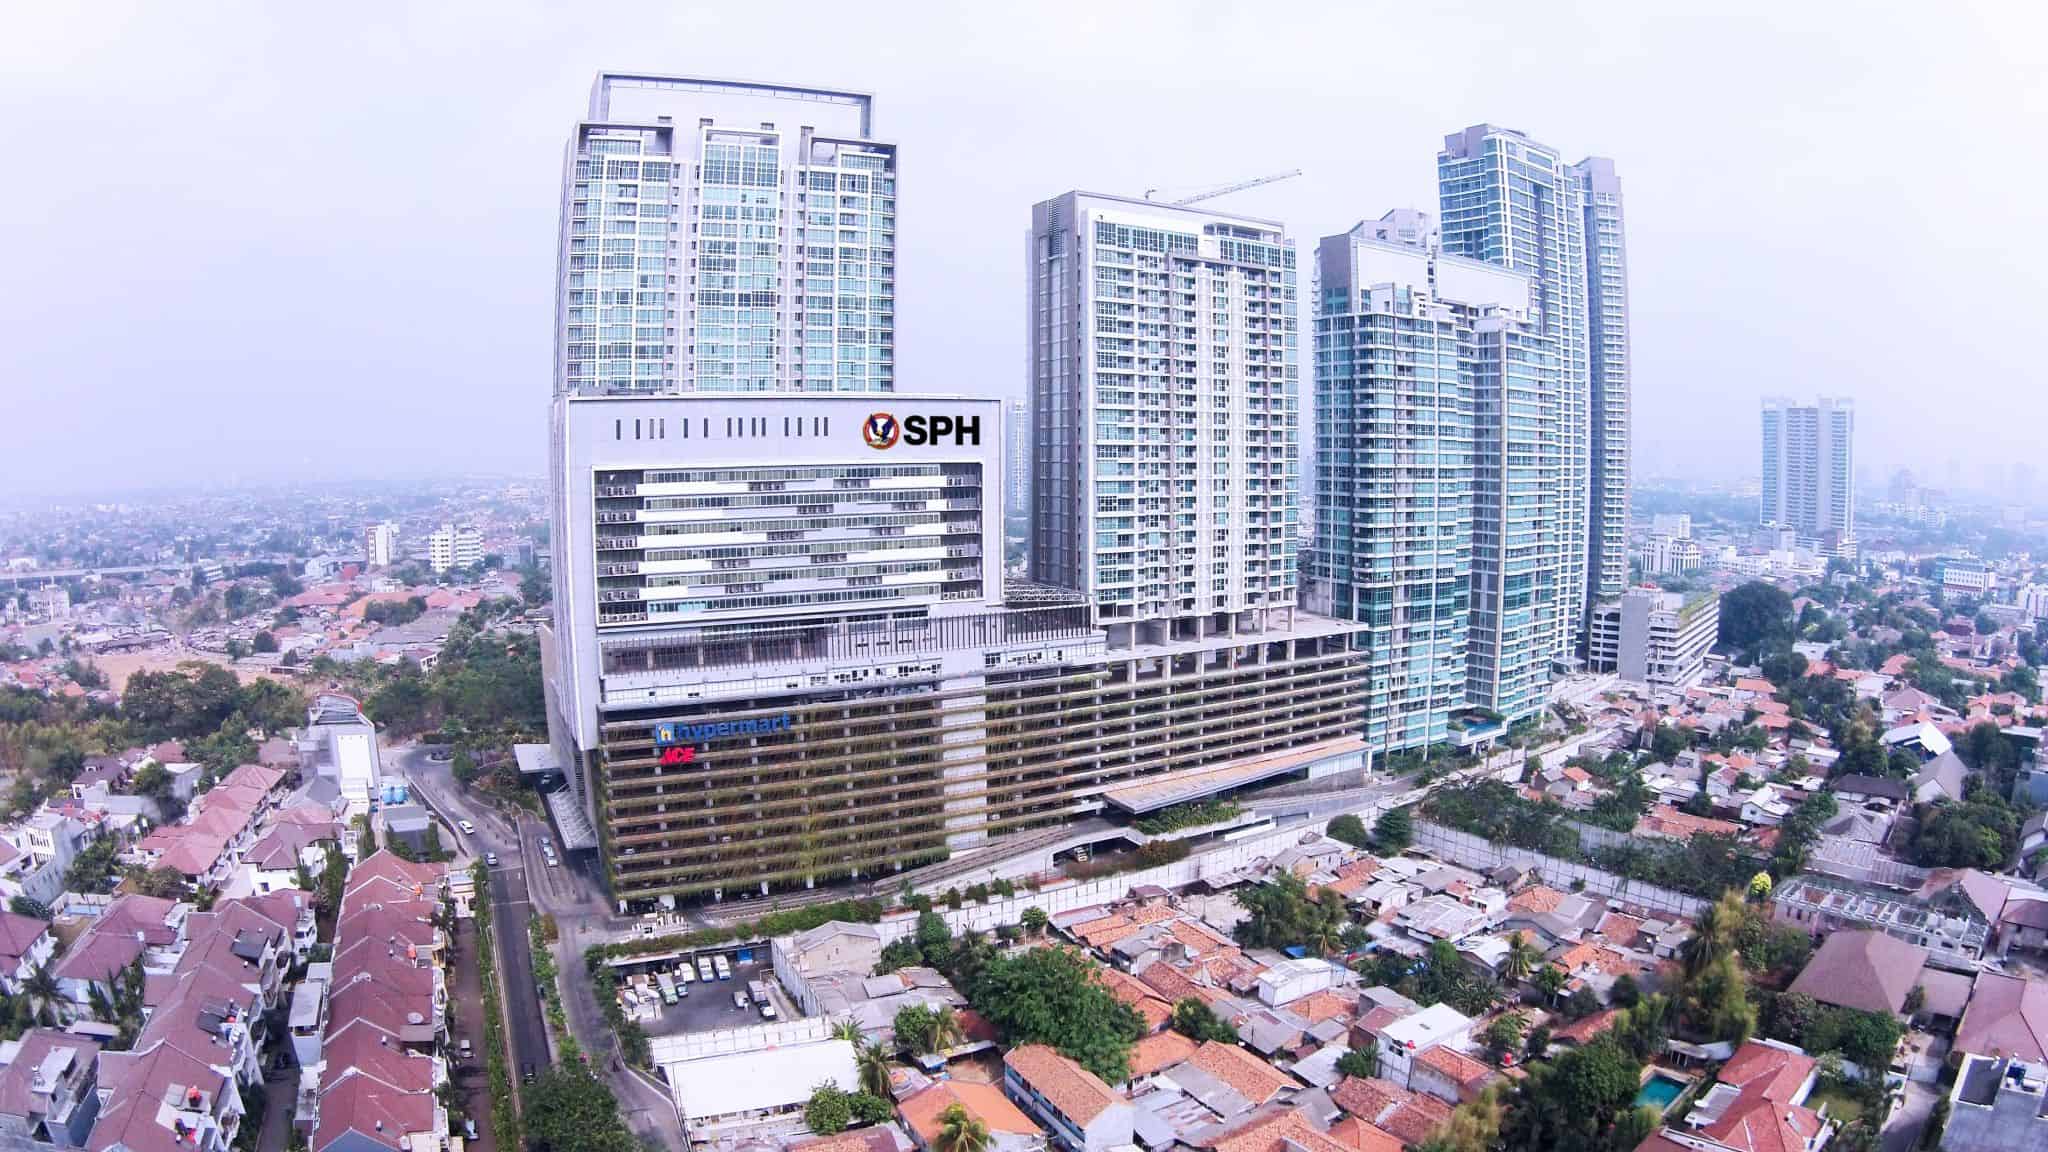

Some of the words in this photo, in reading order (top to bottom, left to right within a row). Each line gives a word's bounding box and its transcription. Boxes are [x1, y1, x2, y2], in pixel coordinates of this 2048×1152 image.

[903, 414, 981, 446] SPH
[677, 711, 791, 742] hypermart
[659, 746, 696, 765] ACE
